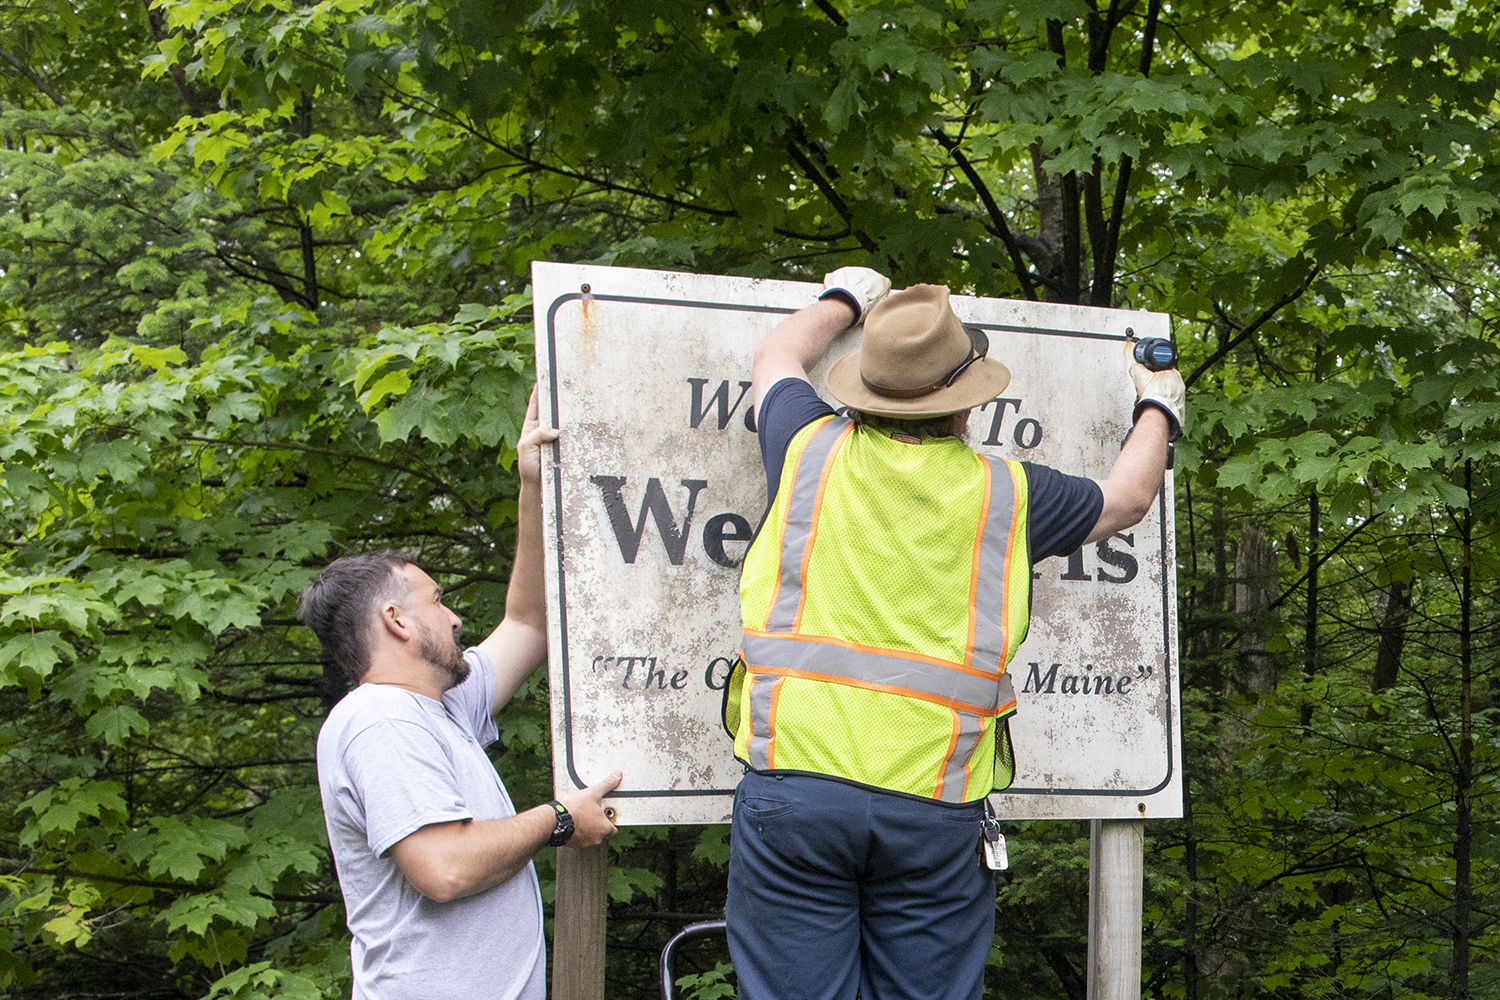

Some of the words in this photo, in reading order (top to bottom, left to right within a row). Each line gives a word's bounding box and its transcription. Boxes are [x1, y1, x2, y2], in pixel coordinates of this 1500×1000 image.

[981, 398, 1043, 449] To
[590, 475, 752, 568] We
[1021, 662, 1152, 695] Maine”
